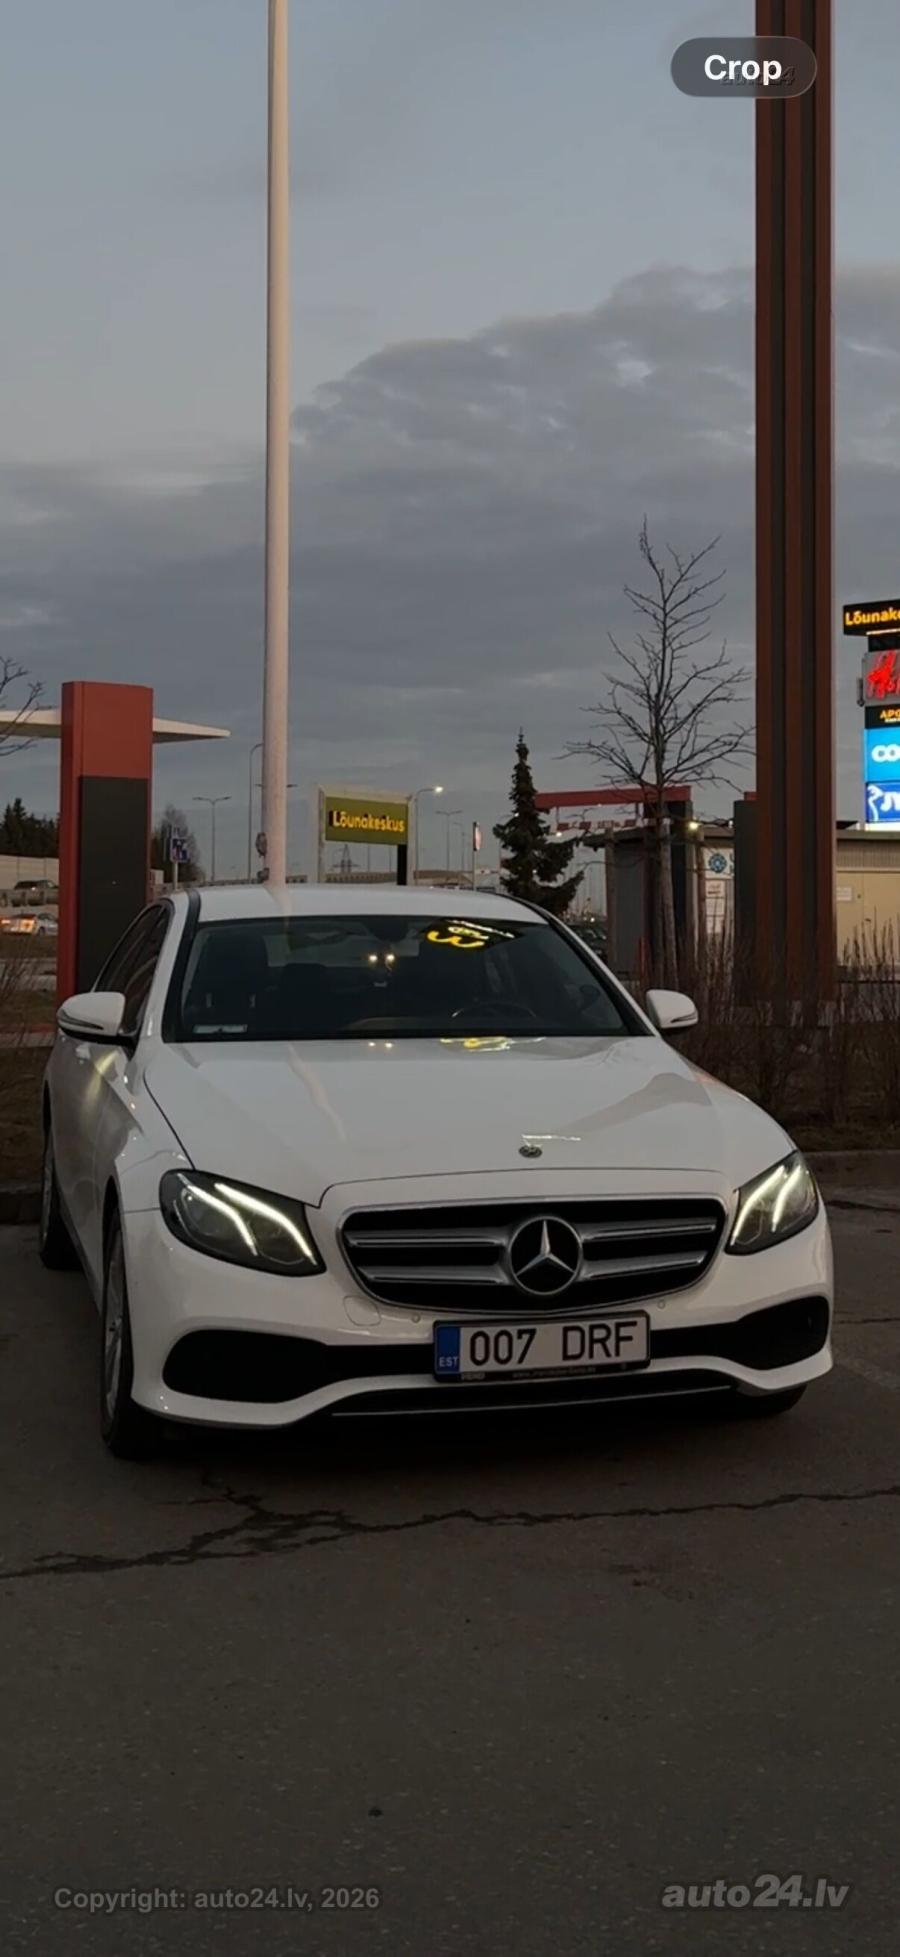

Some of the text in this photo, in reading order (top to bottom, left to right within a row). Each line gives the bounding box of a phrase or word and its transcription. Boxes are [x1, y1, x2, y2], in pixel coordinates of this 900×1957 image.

[332, 810, 405, 833] Lõunakeskus
[439, 1321, 638, 1368] EST 007 DRF
